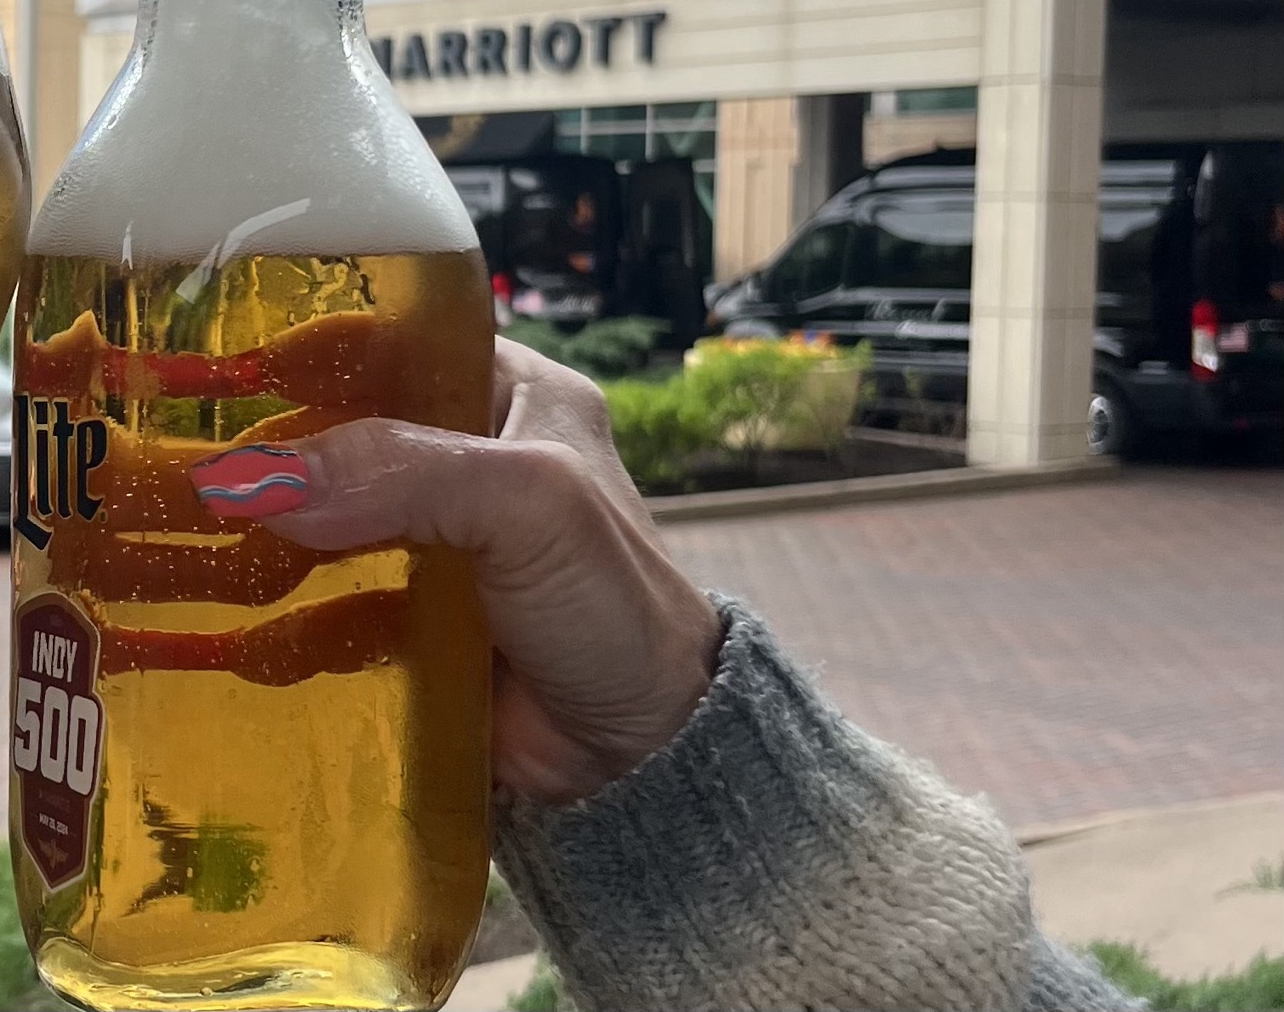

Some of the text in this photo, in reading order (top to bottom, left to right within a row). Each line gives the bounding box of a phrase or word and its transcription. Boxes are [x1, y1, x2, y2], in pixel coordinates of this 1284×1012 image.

[14, 394, 108, 551] Lite
[32, 630, 78, 683] INDY
[15, 676, 99, 796] 500
